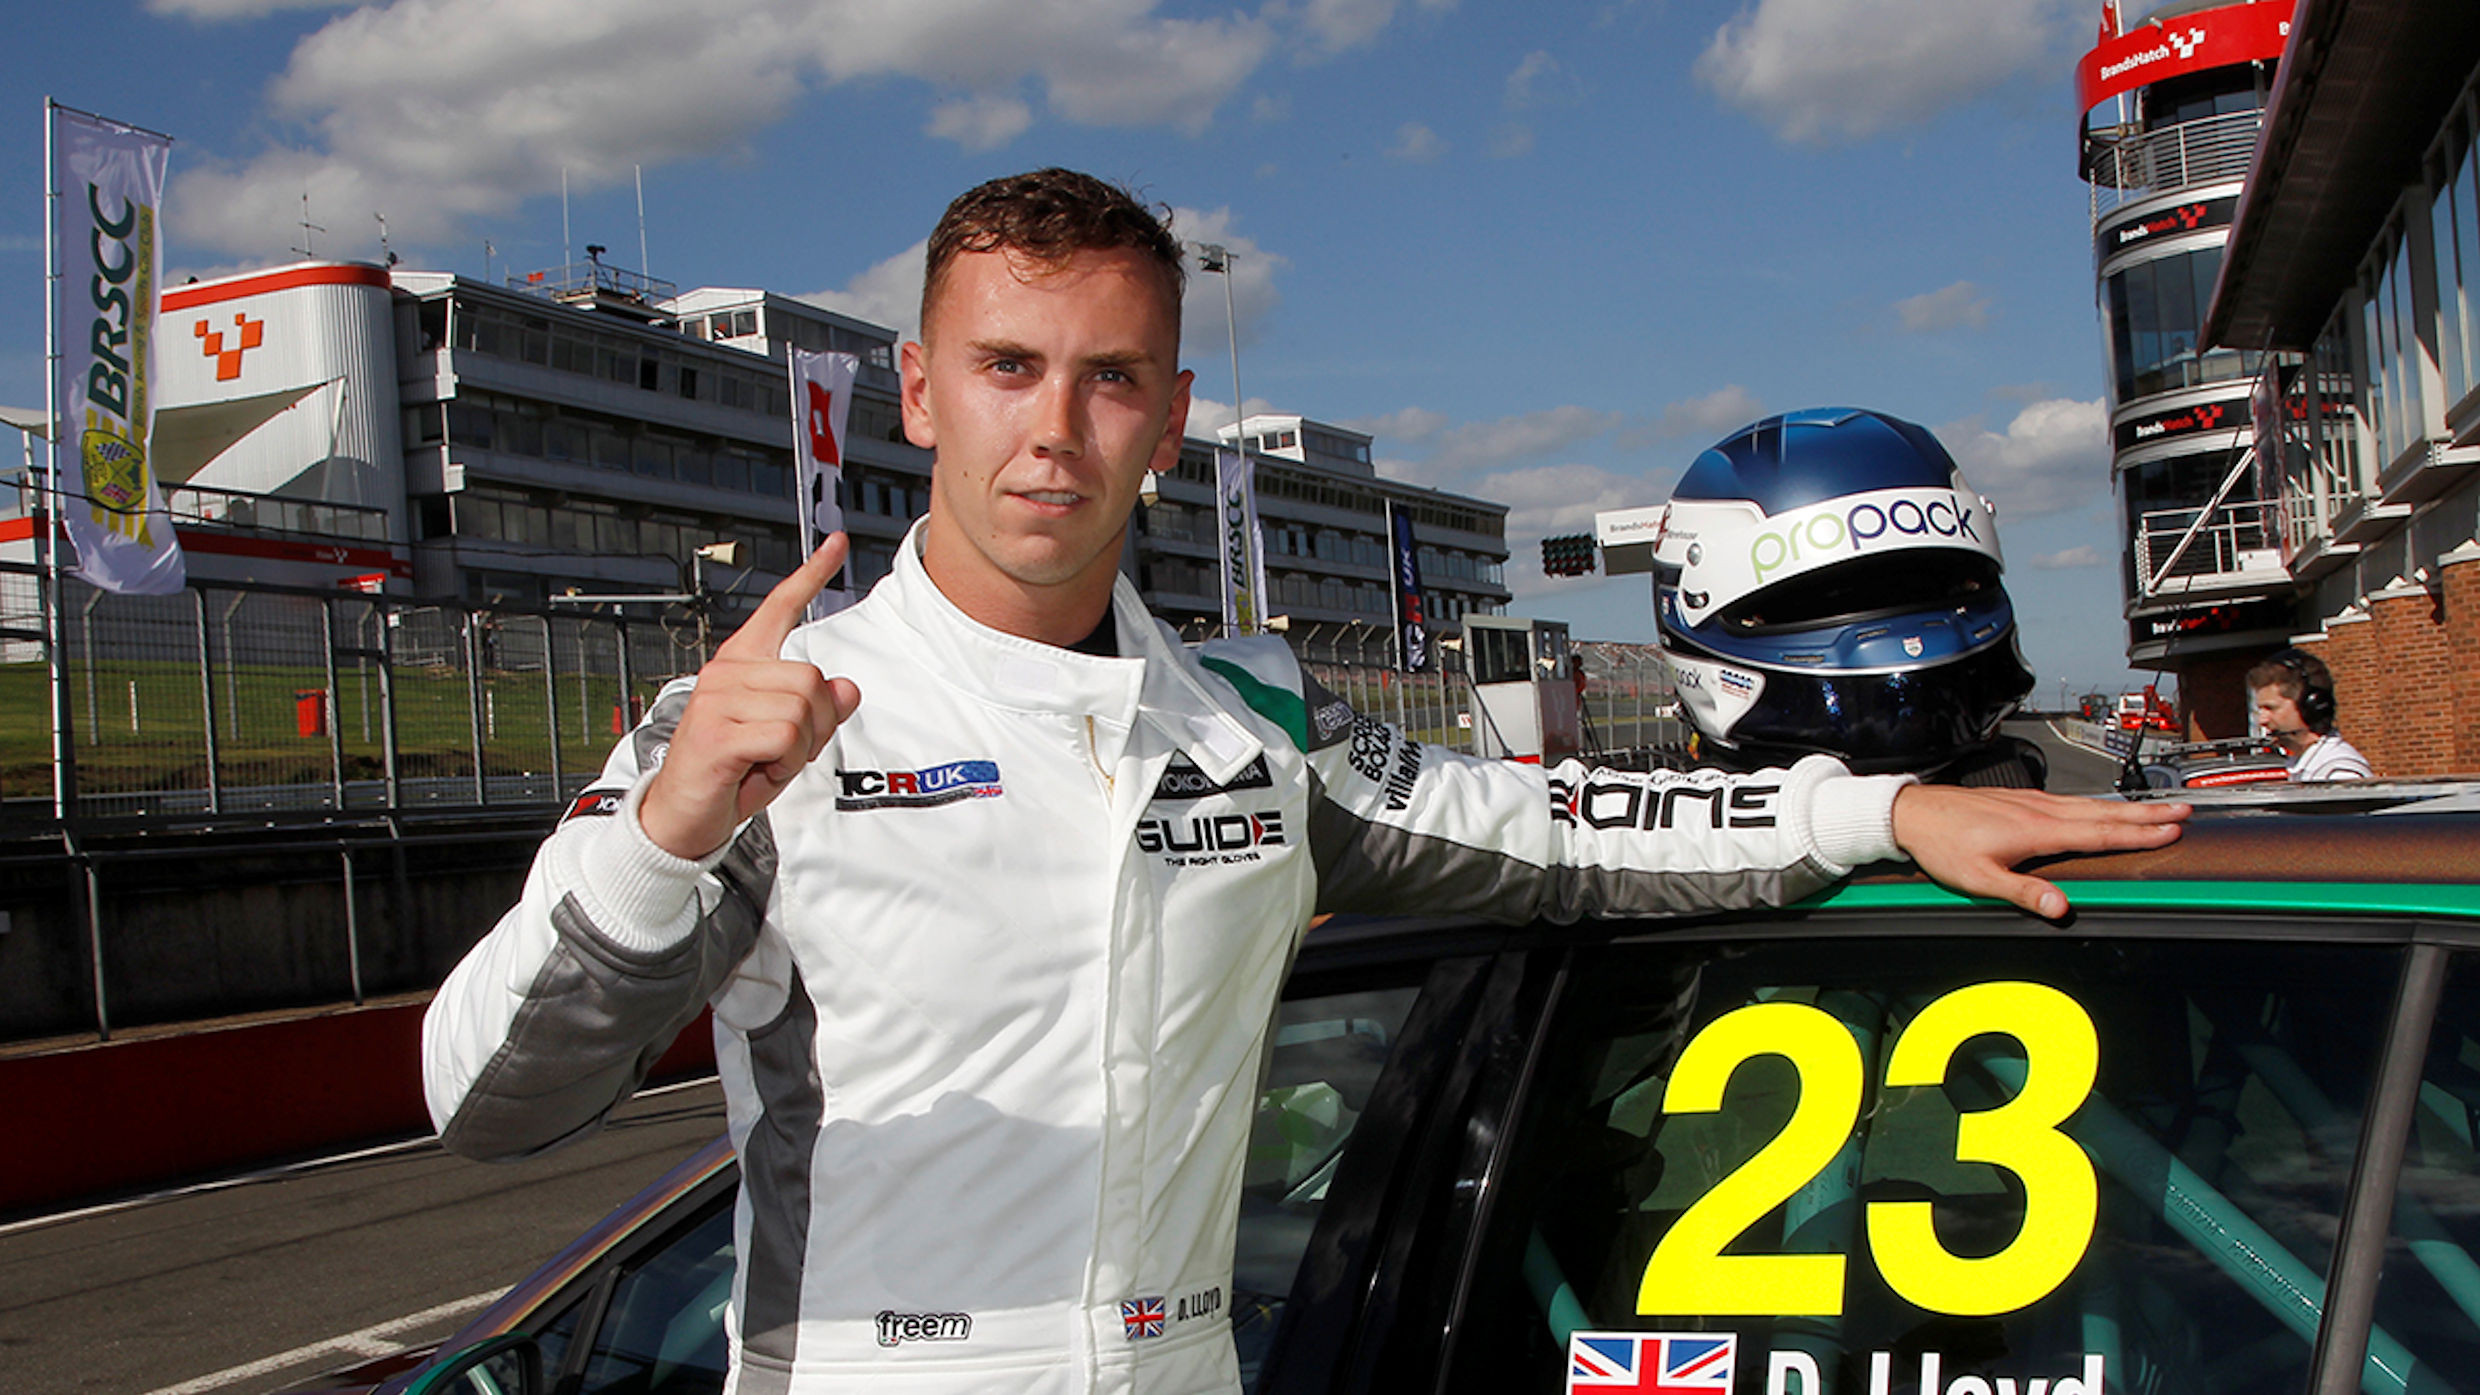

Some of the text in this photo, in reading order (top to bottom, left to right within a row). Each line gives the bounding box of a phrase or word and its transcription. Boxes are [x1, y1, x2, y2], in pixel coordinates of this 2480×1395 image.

[2100, 44, 2170, 82] BrandsHatch
[88, 180, 136, 420] BRSCC
[1226, 484, 1246, 589] BRSCC
[1751, 493, 1981, 584] propack
[835, 765, 968, 798] TCR UK
[1135, 810, 1286, 853] GUIDE
[1635, 980, 2100, 1316] 23
[1178, 1286, 1221, 1321] D. LLOYD
[879, 1312, 970, 1342] freem
